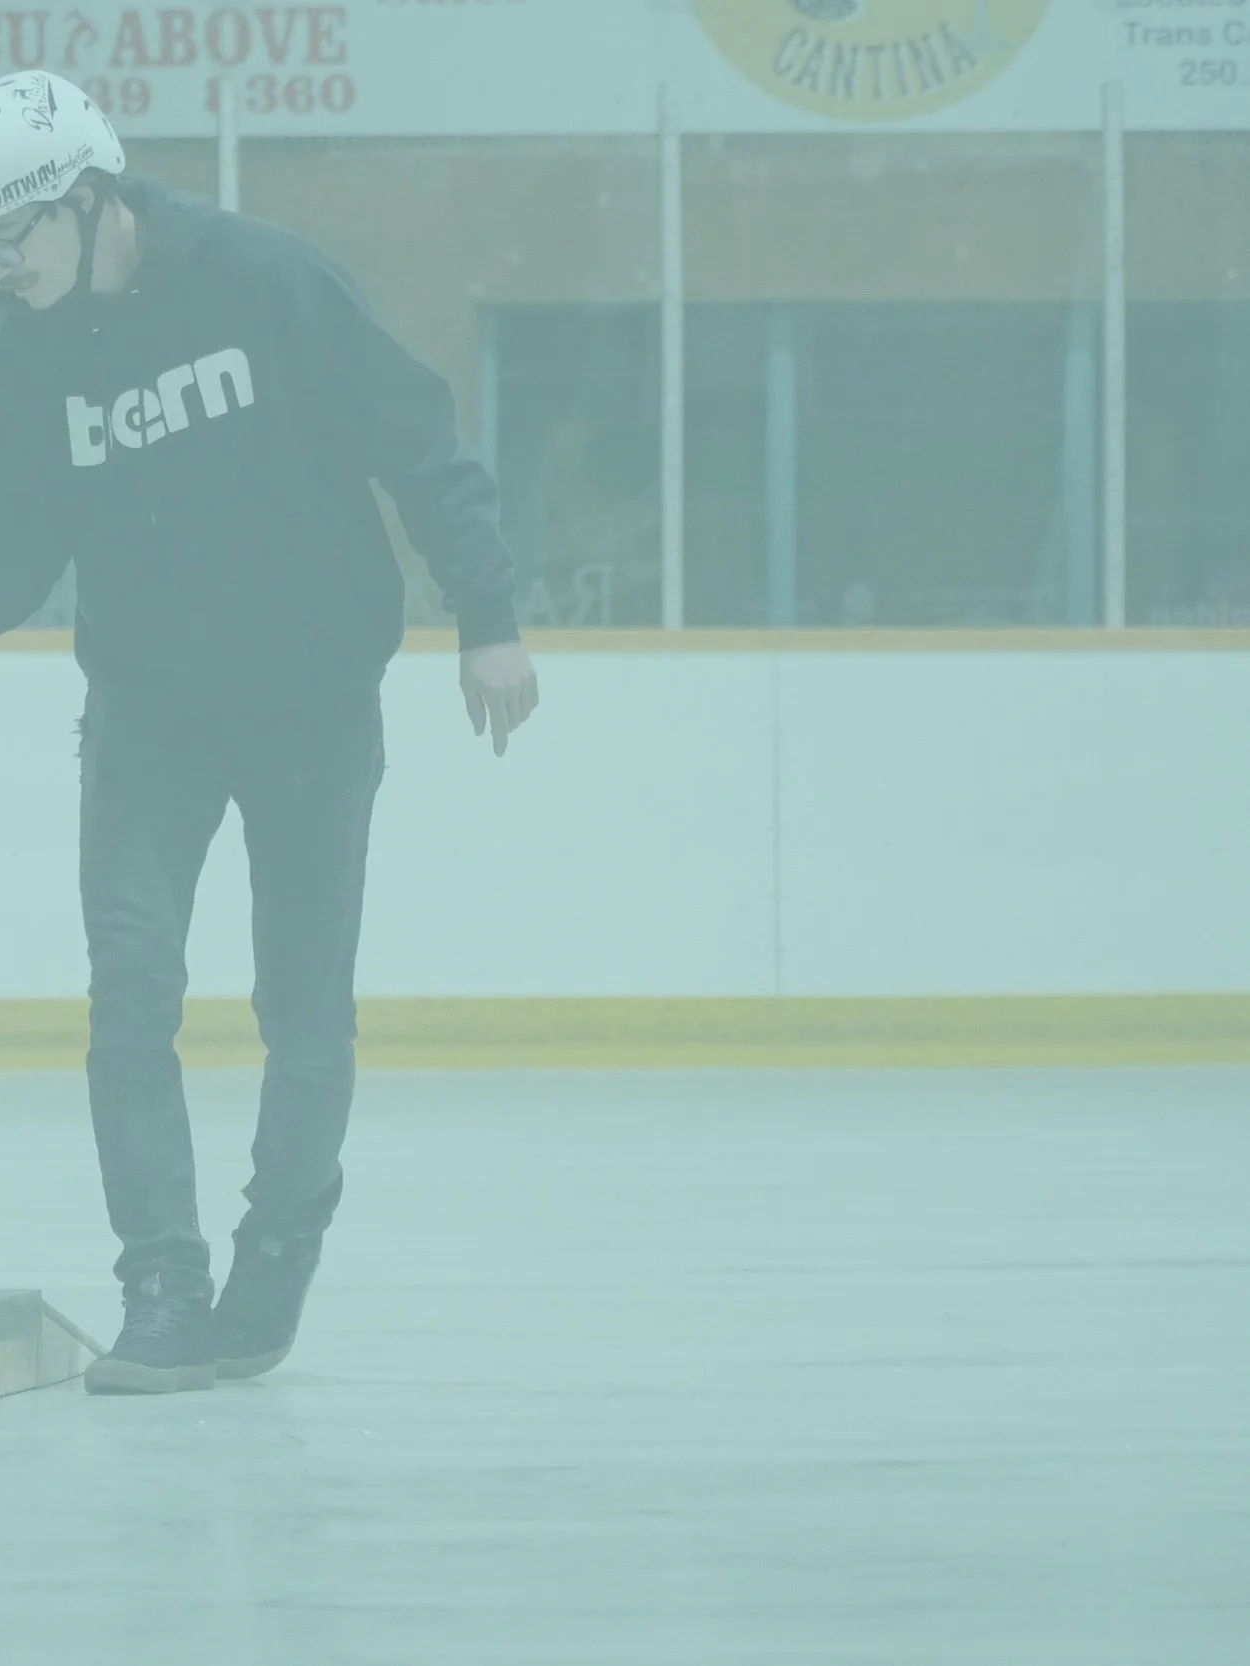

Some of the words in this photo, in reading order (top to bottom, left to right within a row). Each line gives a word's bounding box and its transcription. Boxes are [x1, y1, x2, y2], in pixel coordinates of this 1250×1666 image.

[106, 6, 348, 69] ABOVE
[773, 21, 979, 100] CANTINA
[1123, 18, 1213, 47] Trans
[66, 347, 254, 467] bern
